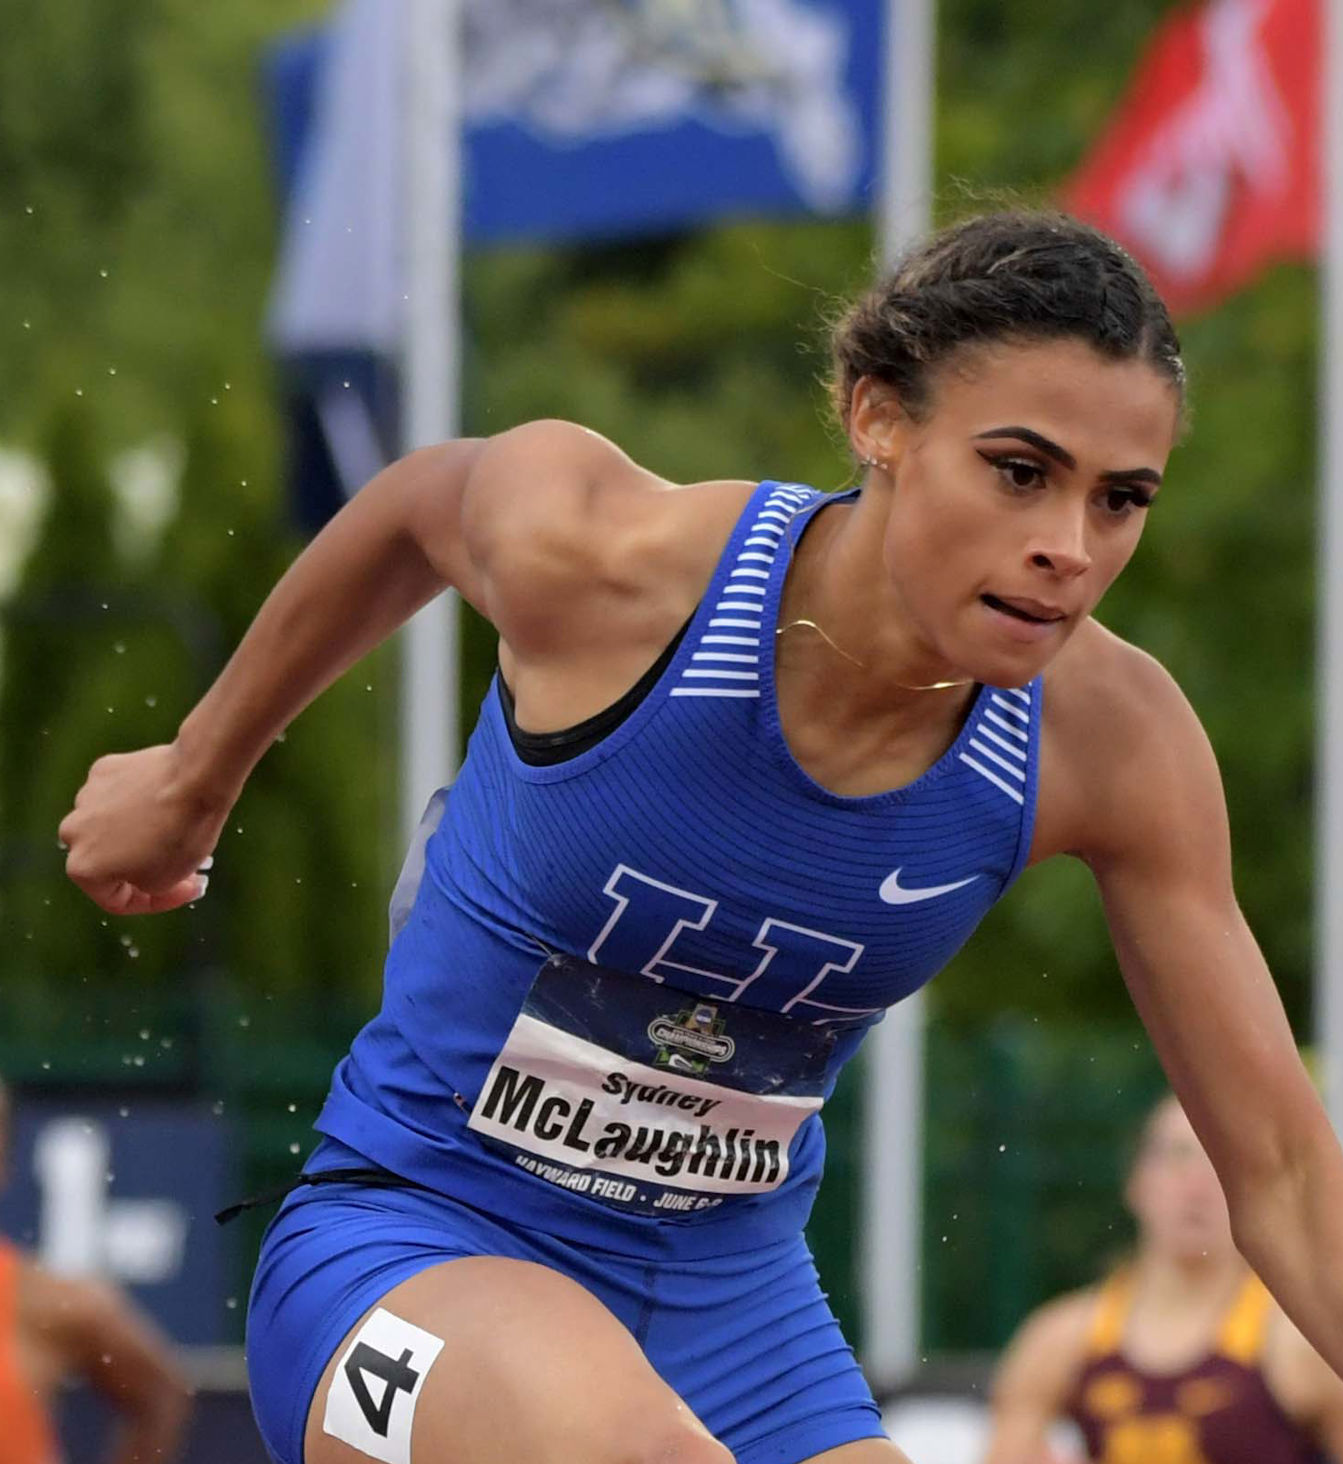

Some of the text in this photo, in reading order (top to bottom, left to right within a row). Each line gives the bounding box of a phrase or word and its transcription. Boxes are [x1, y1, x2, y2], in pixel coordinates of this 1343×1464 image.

[480, 1065, 781, 1184] McLaughlin
[602, 1072, 722, 1117] Sydney
[590, 1178, 638, 1202] FIELD
[344, 1341, 420, 1438] 4
